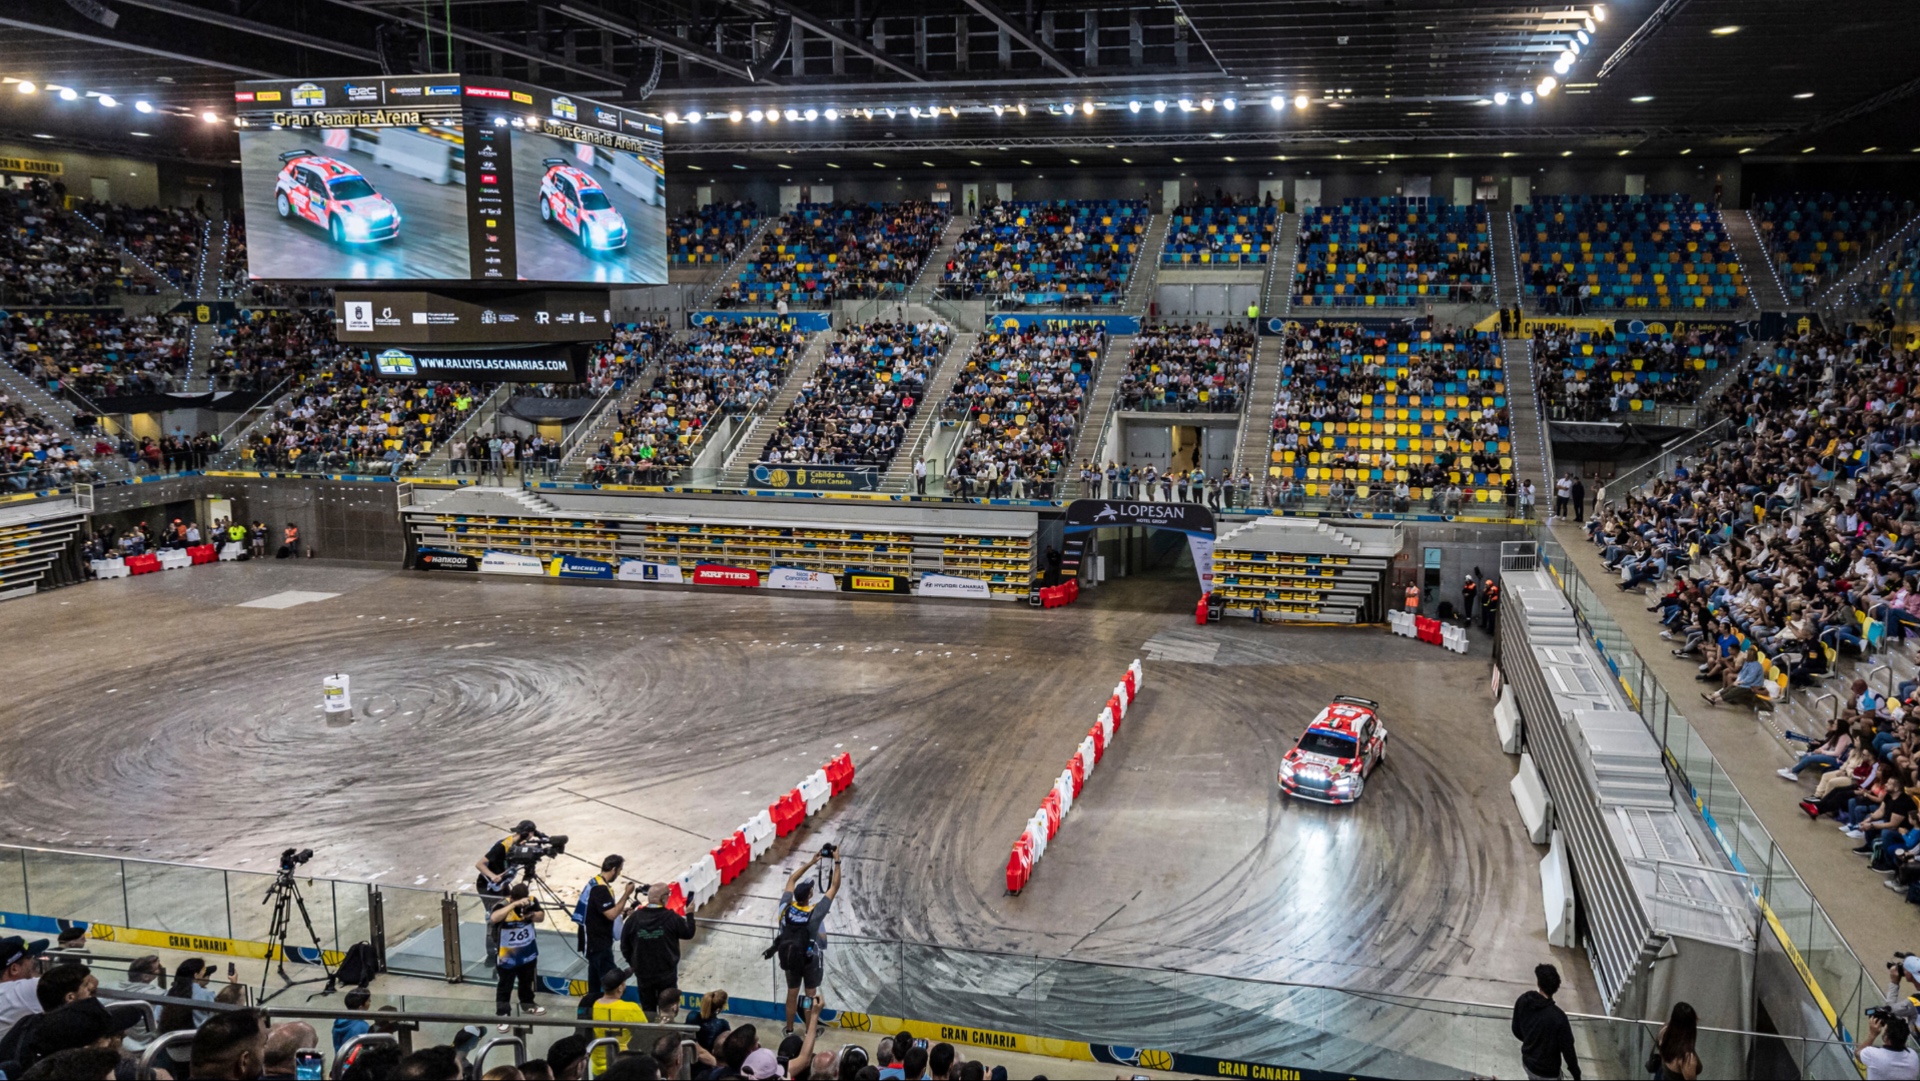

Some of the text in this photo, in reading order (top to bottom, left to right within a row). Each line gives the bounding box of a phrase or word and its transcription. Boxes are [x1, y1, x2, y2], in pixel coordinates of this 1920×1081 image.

[274, 110, 420, 127] Gran Canaria Arena
[573, 127, 612, 146] Canaria
[614, 136, 643, 152] Arena
[419, 357, 568, 371] WWW.RALLYISLASCANARIAS.COM
[1120, 504, 1185, 518] LOPESAN
[856, 578, 890, 588] PIRELLI
[169, 935, 227, 952] GRAN CANARIA
[509, 929, 529, 941] 263
[941, 1026, 1016, 1048] GRAN CANARIA
[1218, 1061, 1300, 1080] GRAN CANARIA
